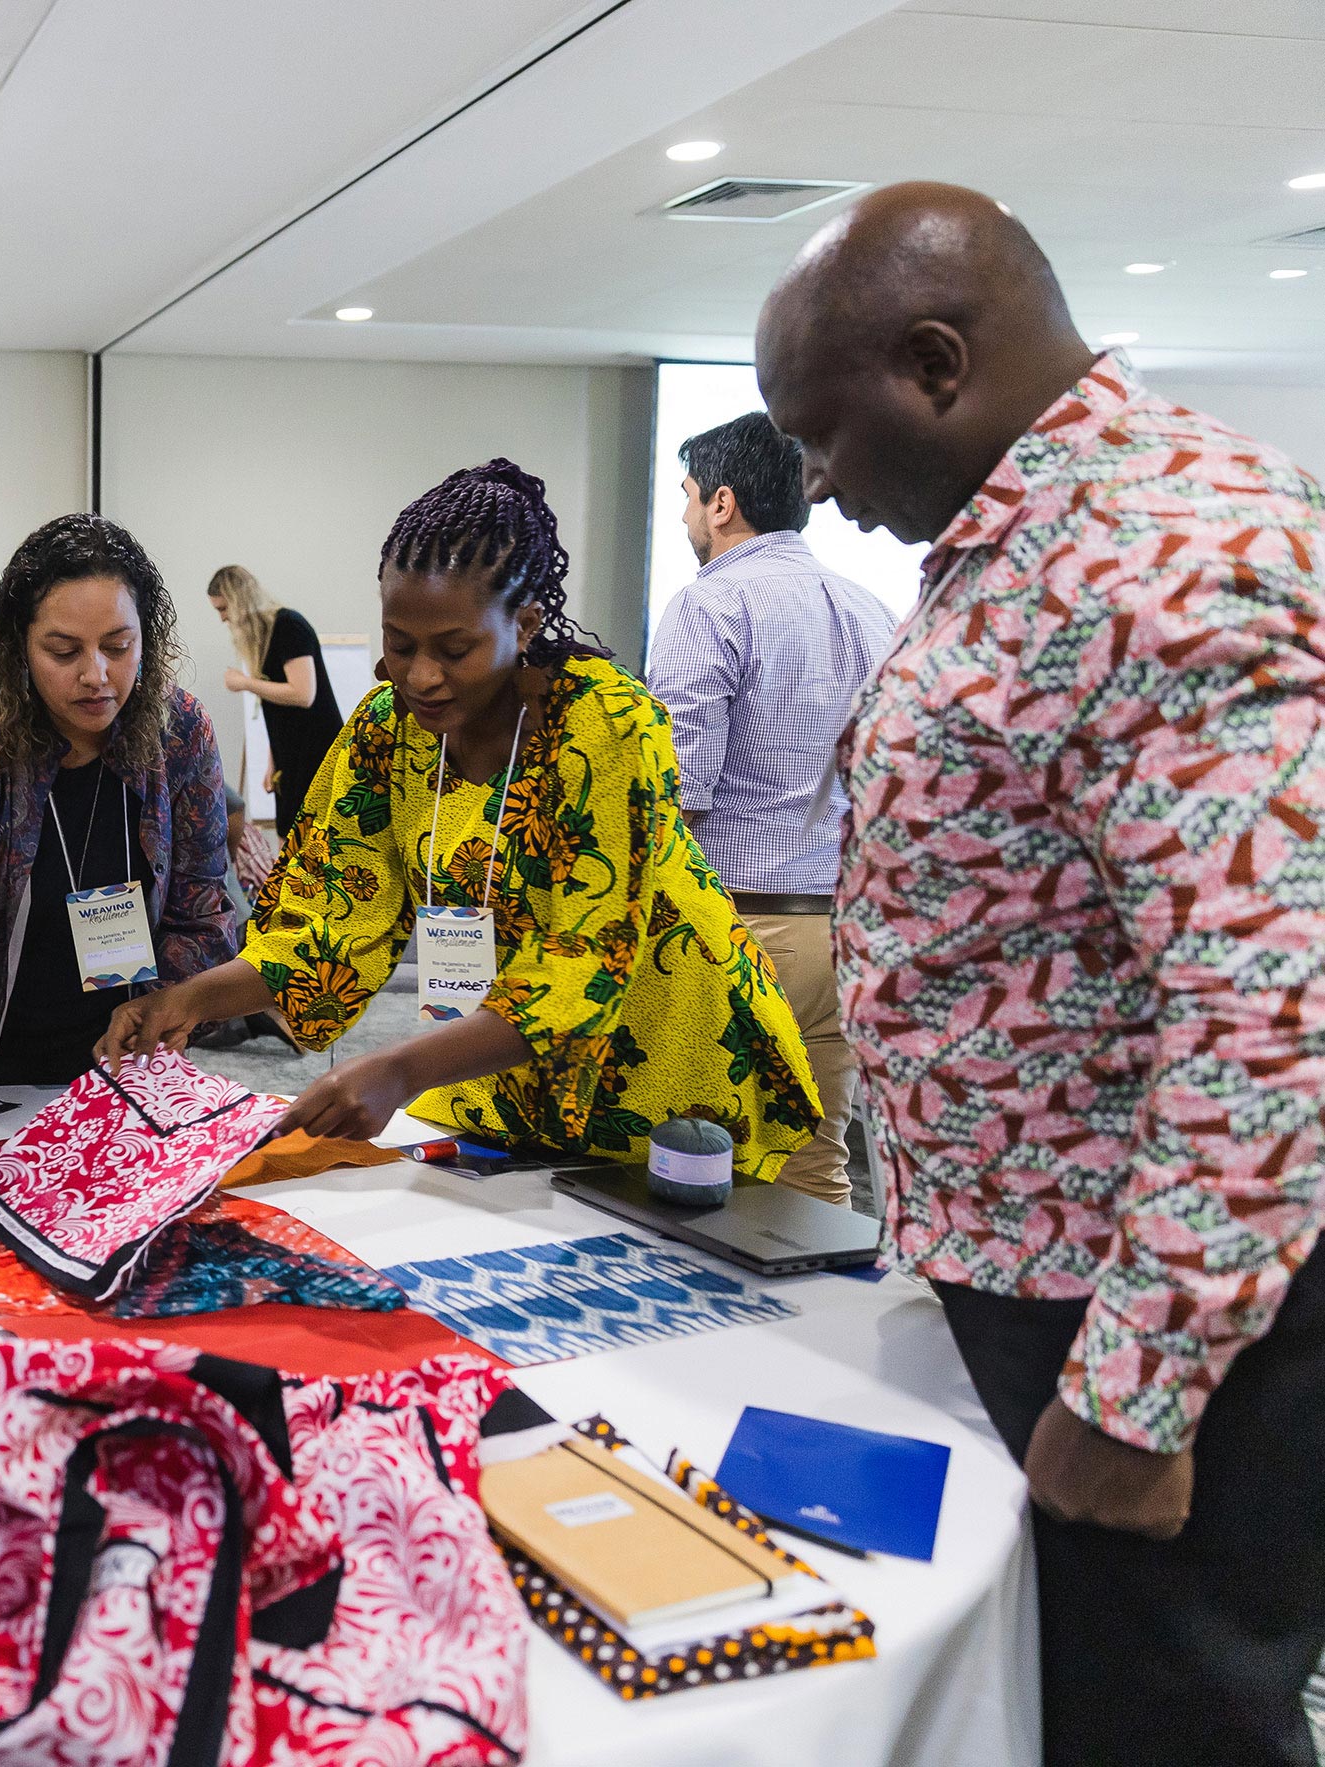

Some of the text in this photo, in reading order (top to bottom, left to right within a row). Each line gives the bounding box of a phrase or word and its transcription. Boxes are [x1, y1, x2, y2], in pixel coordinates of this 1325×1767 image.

[78, 901, 134, 918] WEAVING
[89, 910, 129, 925] Resilience
[426, 927, 483, 940] WEAVING
